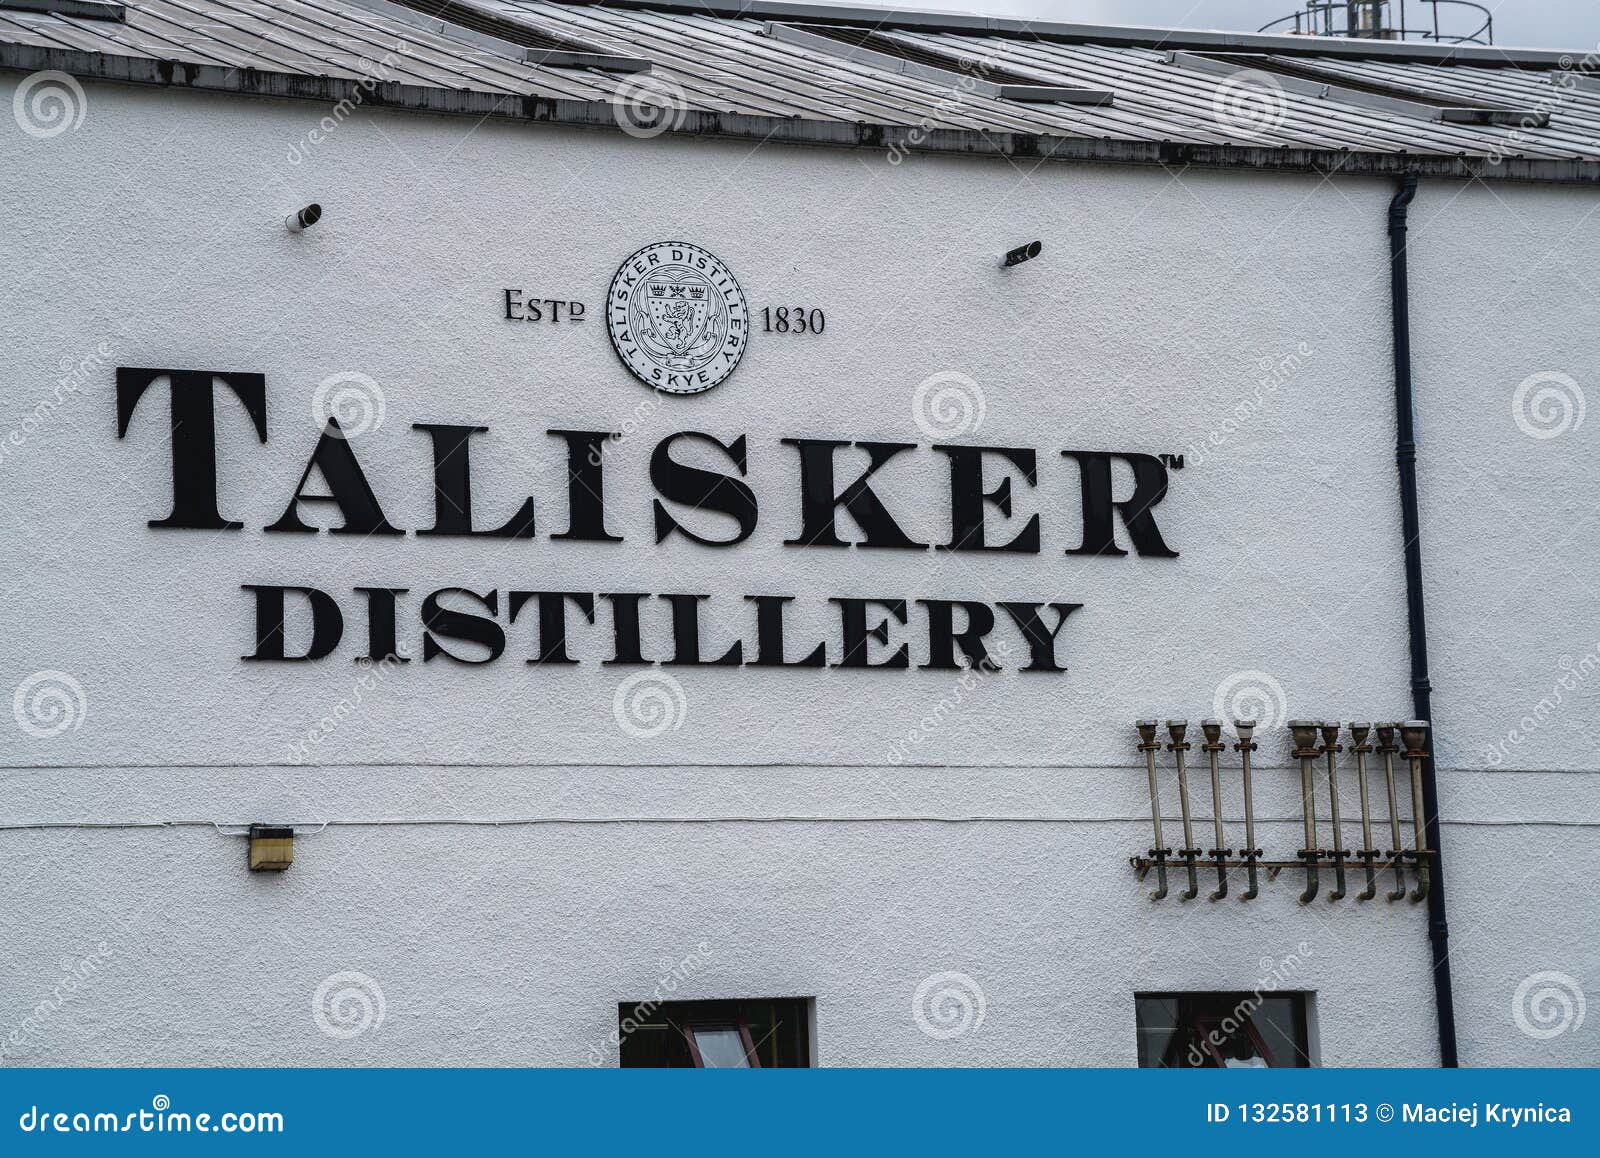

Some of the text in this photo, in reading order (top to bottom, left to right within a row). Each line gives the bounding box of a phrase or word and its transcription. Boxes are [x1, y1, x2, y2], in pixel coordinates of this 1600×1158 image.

[615, 249, 742, 364] TALISKER DISTILLERY
[762, 306, 825, 335] 1830
[651, 368, 710, 387] SKYE
[116, 366, 1180, 558] TALISKER
[241, 584, 1083, 673] DISTILLERY
